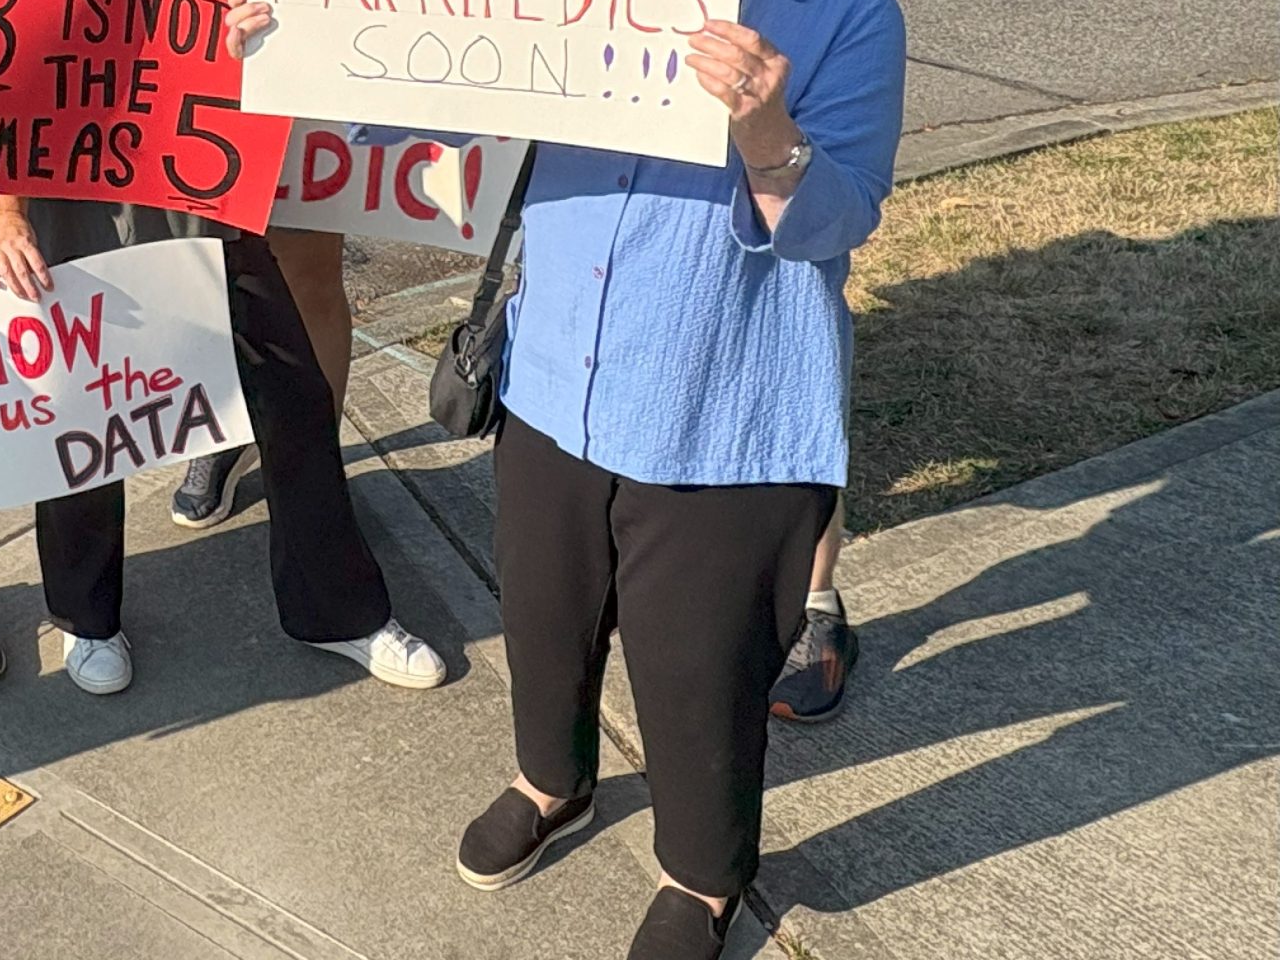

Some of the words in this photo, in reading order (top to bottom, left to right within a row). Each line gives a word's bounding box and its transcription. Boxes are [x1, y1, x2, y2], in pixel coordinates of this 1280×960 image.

[44, 54, 159, 115] THE
[66, 121, 143, 187] AS
[161, 93, 242, 200] 5
[84, 356, 183, 411] the
[54, 383, 227, 490] DATA
